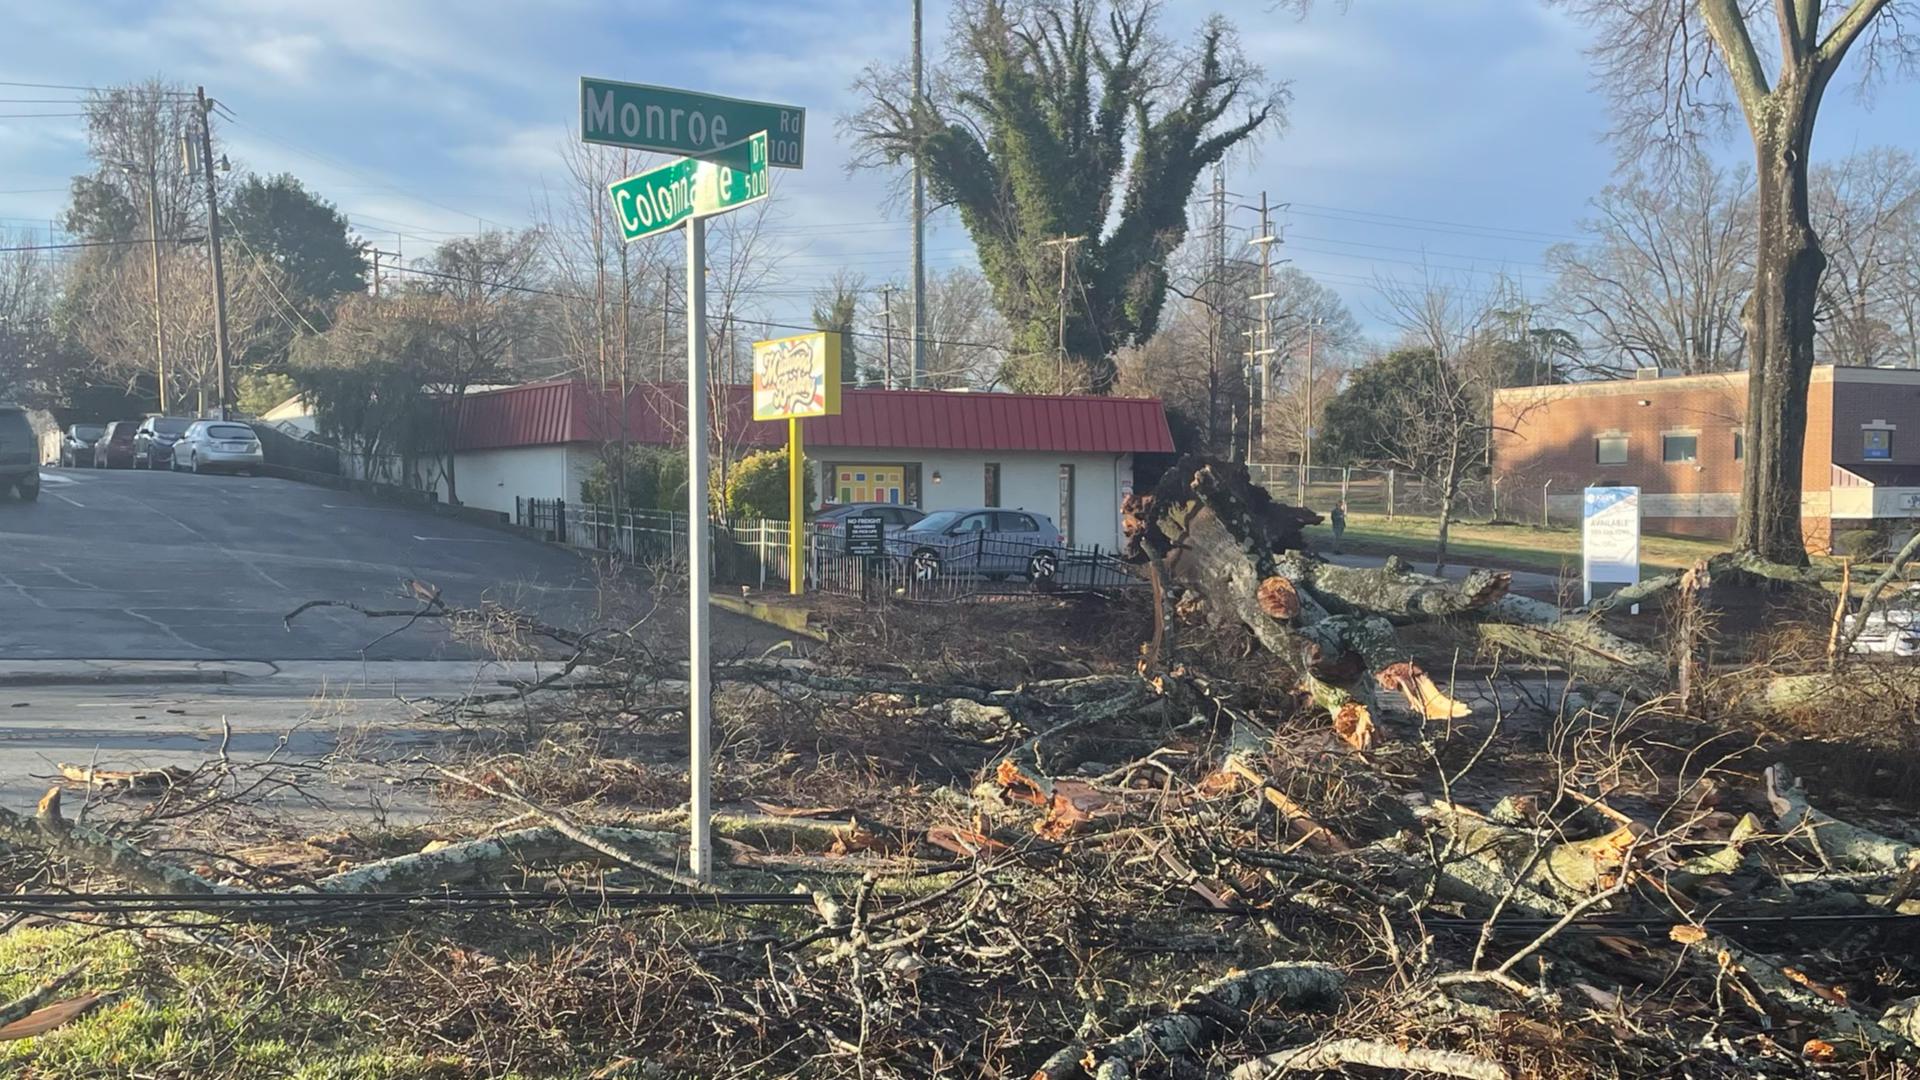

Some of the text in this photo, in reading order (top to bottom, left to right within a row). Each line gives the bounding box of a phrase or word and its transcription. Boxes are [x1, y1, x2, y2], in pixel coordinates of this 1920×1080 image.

[585, 87, 800, 148] Monroe Rd
[771, 139, 798, 162] 100
[616, 139, 766, 232] Colonnae Dr
[745, 171, 766, 199] 500
[1590, 519, 1629, 527] AVAILABLE
